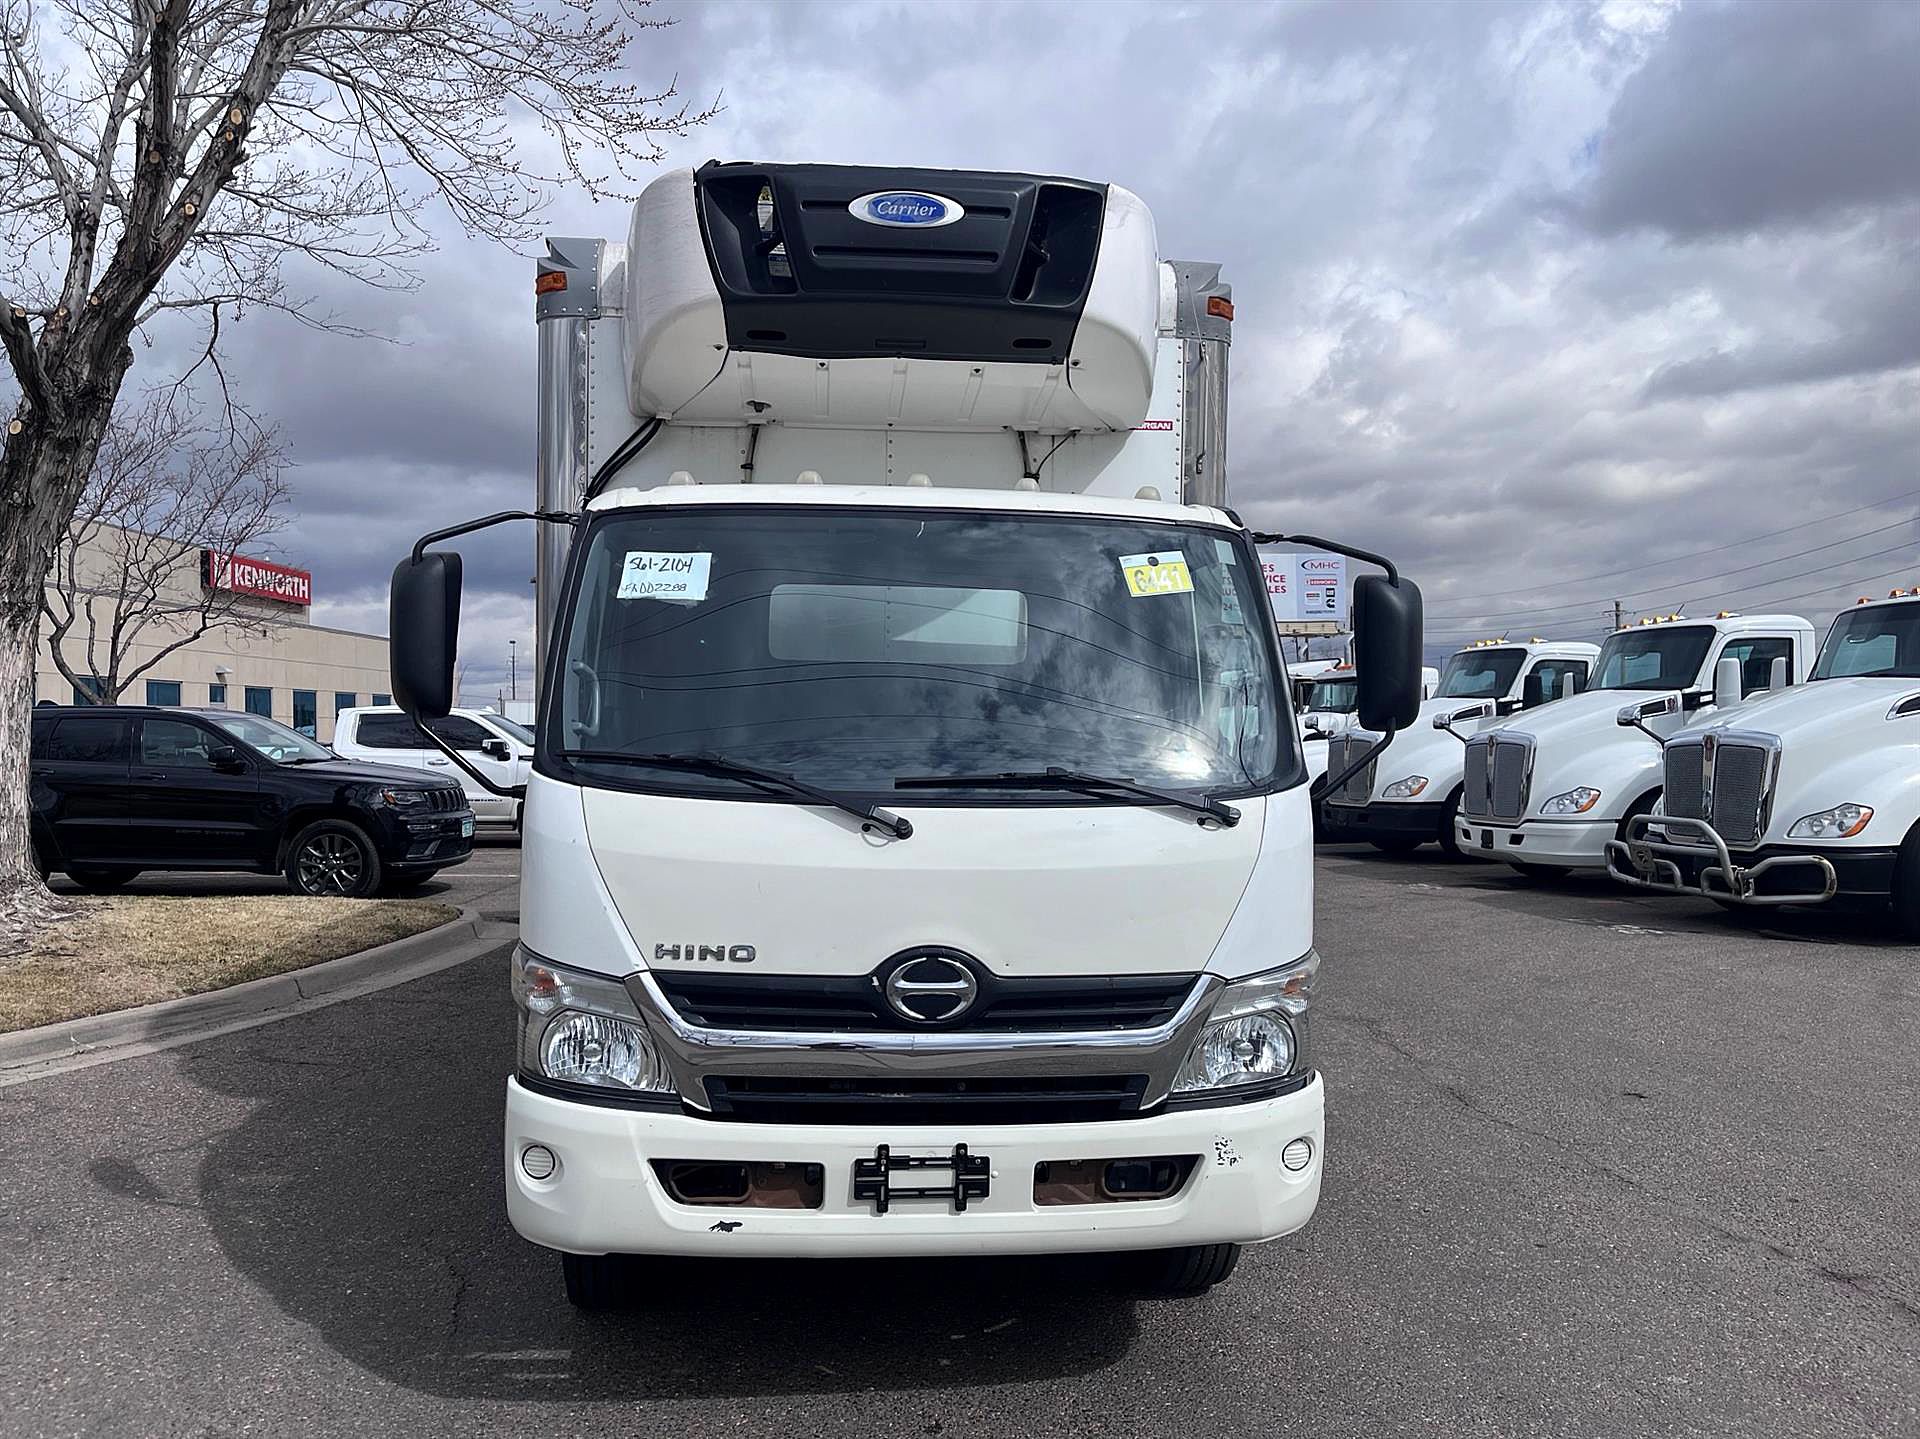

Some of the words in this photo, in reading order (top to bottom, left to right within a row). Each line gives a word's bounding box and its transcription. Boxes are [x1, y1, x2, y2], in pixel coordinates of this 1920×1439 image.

[877, 201, 937, 216] Carrier
[234, 563, 309, 599] KENWORTH
[655, 943, 756, 962] HINO
